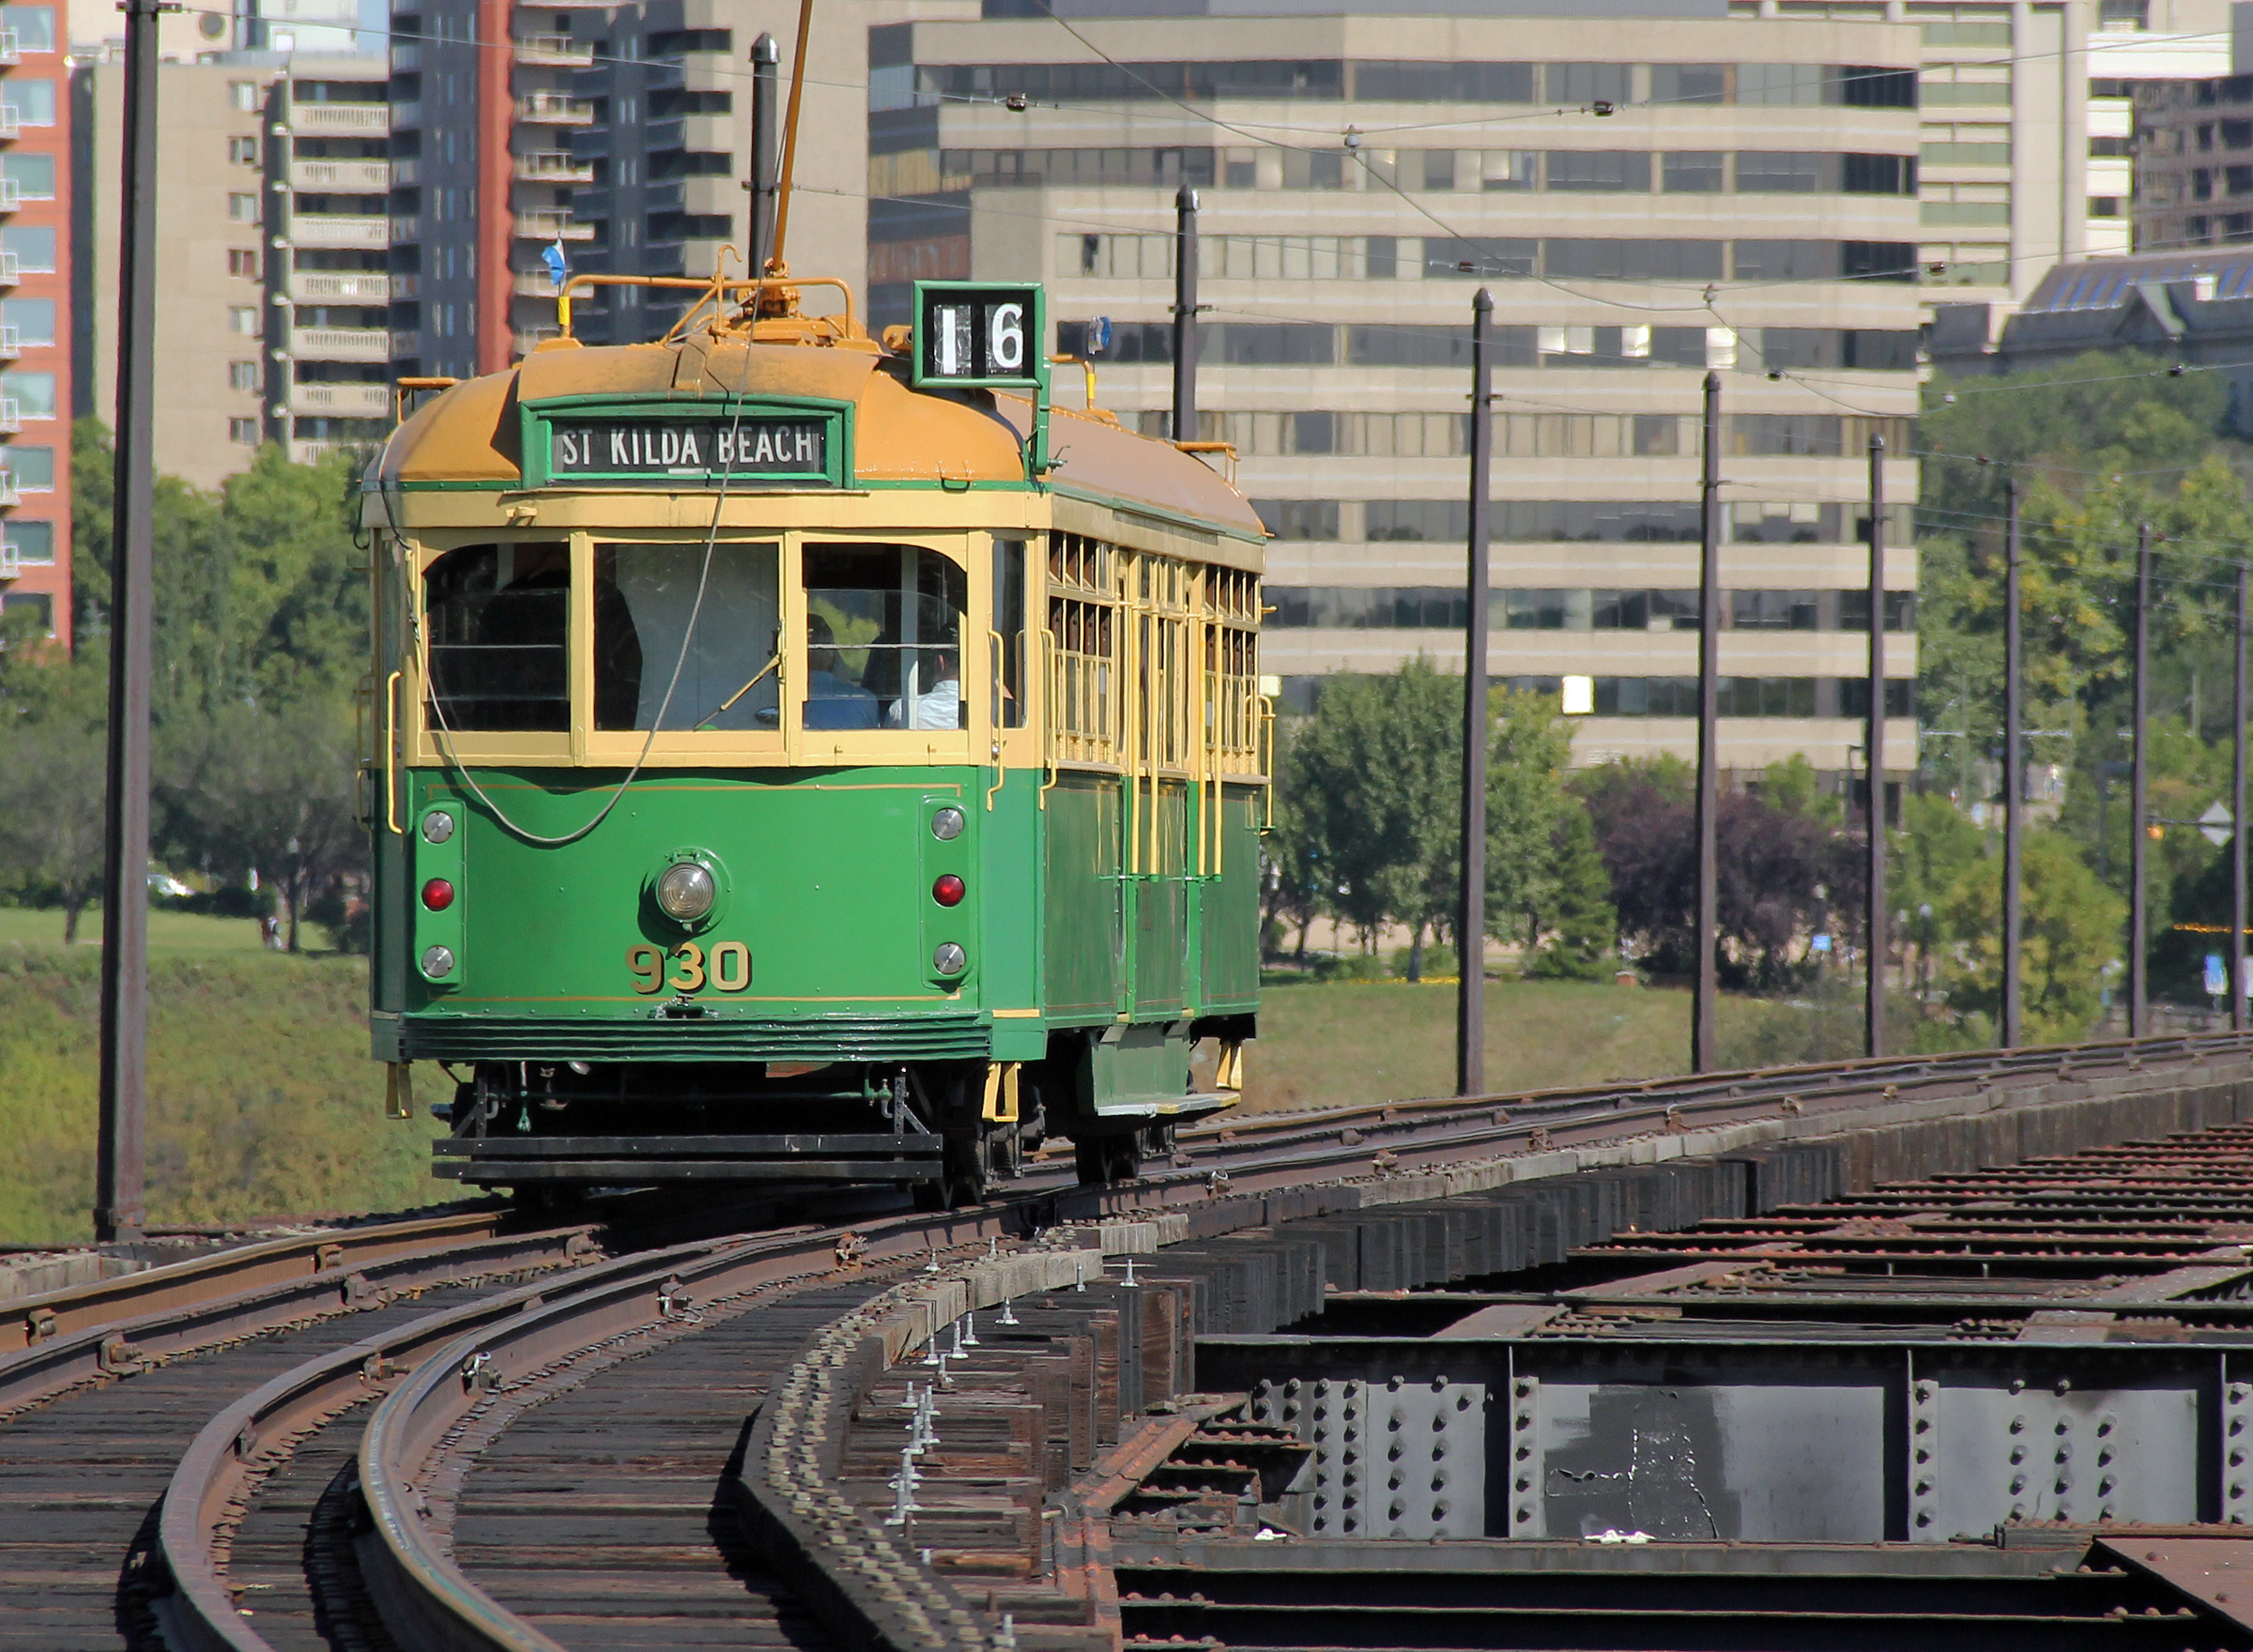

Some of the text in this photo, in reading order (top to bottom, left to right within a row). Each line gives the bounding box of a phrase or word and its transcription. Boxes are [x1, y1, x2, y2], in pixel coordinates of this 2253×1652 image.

[942, 302, 1023, 375] 16
[563, 425, 813, 466] ST KILDA BEACH
[624, 941, 753, 995] 930
